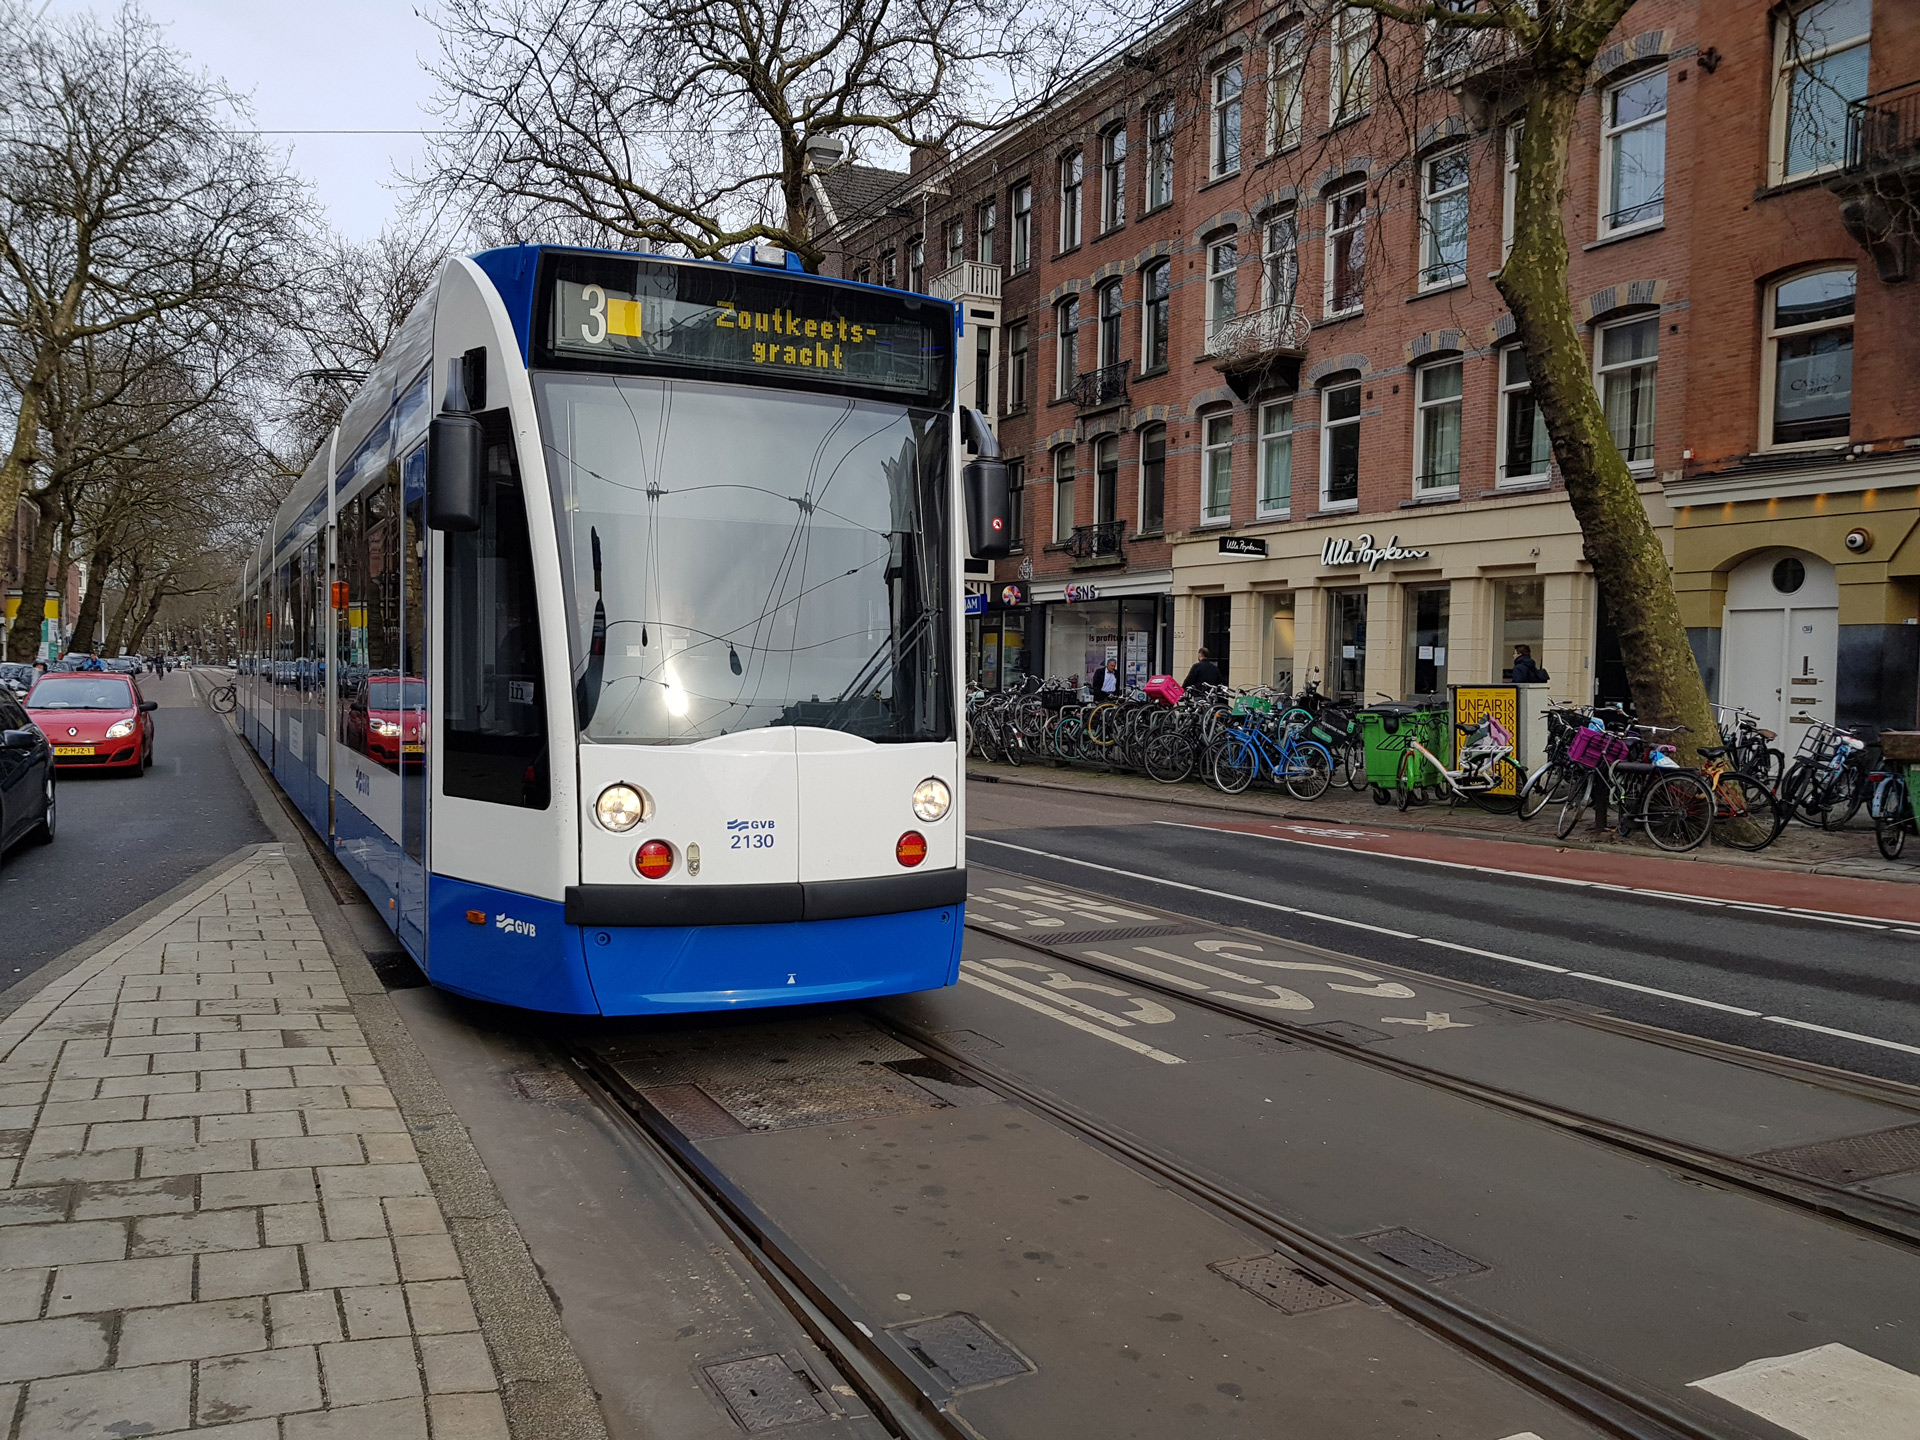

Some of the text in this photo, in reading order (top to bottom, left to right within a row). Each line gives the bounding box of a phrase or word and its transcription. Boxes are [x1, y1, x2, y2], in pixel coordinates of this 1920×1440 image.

[581, 284, 606, 344] 3
[716, 300, 876, 343] Zoutkeets-
[752, 341, 843, 369] gracht
[1226, 539, 1262, 553] Ulla Popken
[1320, 533, 1429, 572] Ulla Popken
[1075, 585, 1096, 600] SNS
[751, 820, 775, 829] GVB
[731, 834, 775, 850] 2130
[515, 920, 536, 938] GVB
